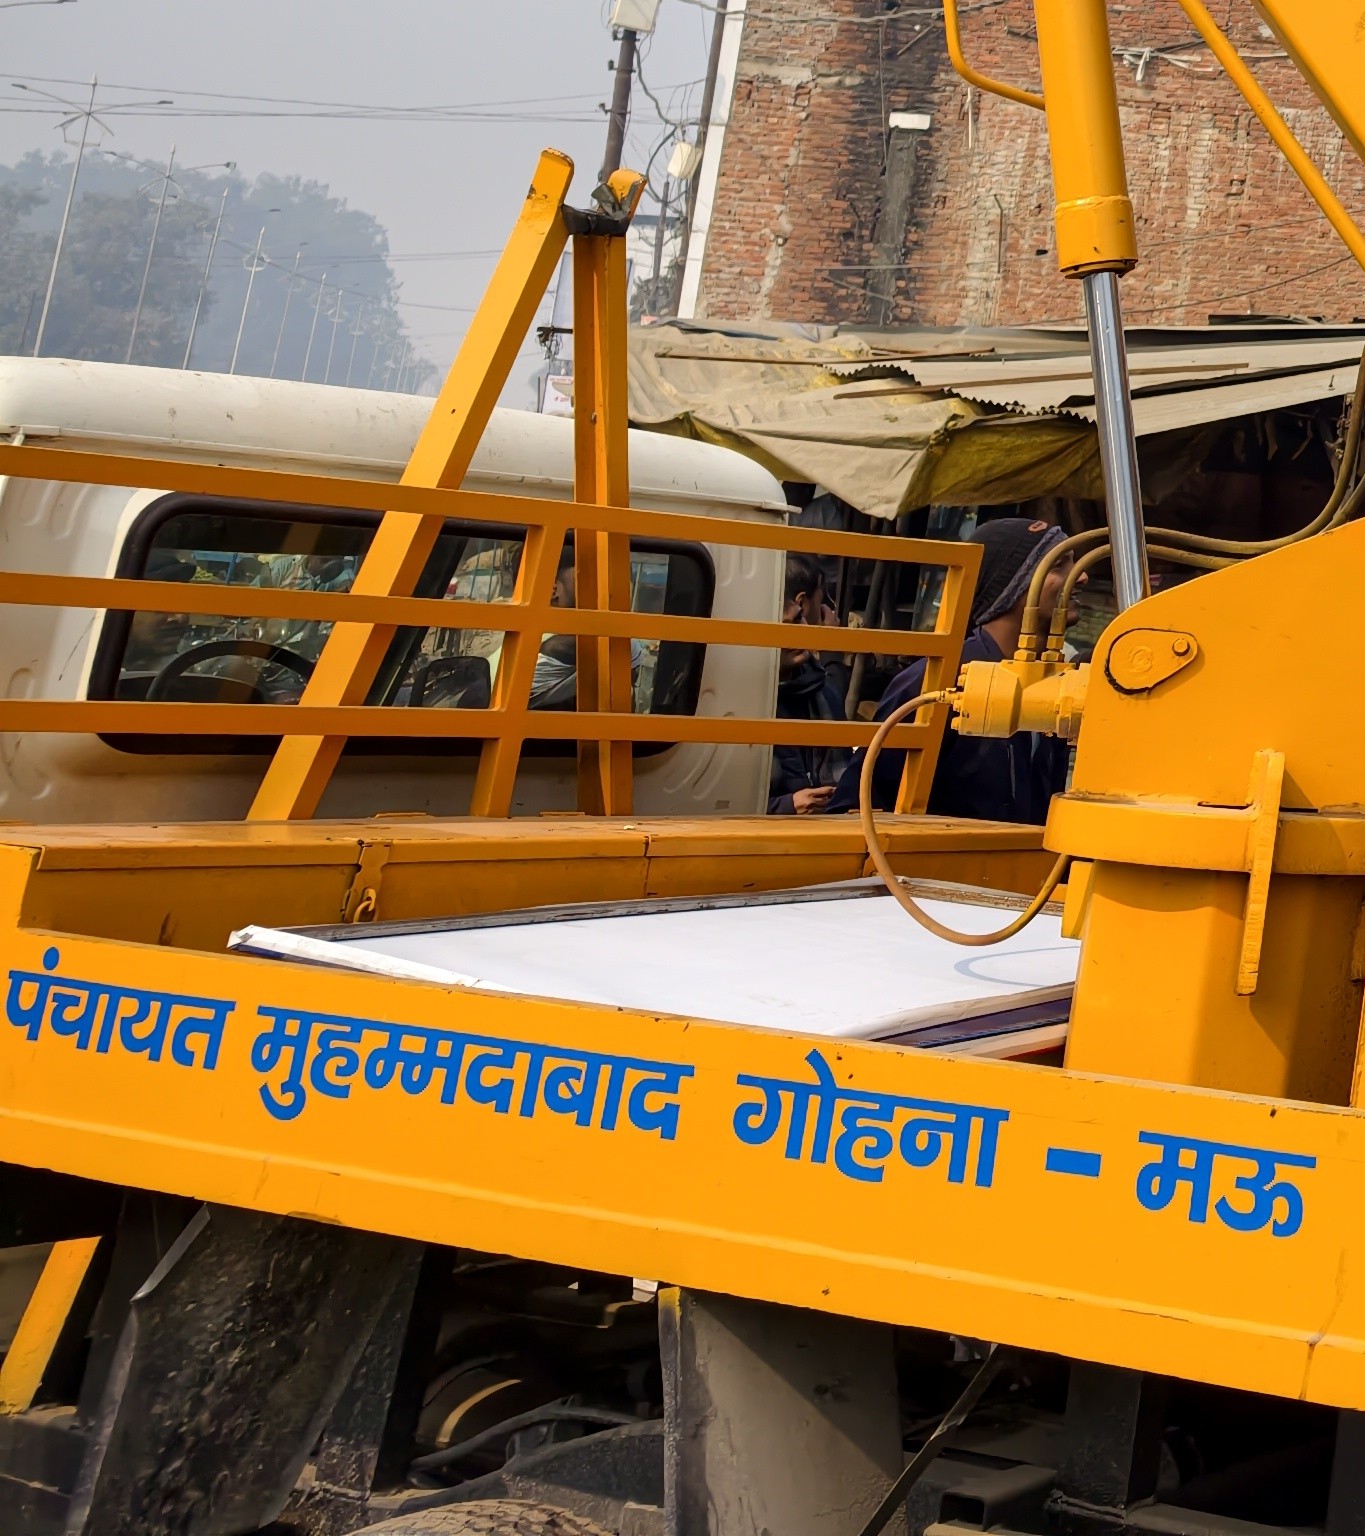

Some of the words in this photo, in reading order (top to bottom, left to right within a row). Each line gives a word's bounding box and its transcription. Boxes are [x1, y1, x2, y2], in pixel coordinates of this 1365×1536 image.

[6, 948, 236, 1070] पंचायत
[251, 1006, 695, 1140] मुहम्मदाबाद
[733, 1050, 1009, 1187] गोहना
[1136, 1131, 1317, 1237] मऊ
